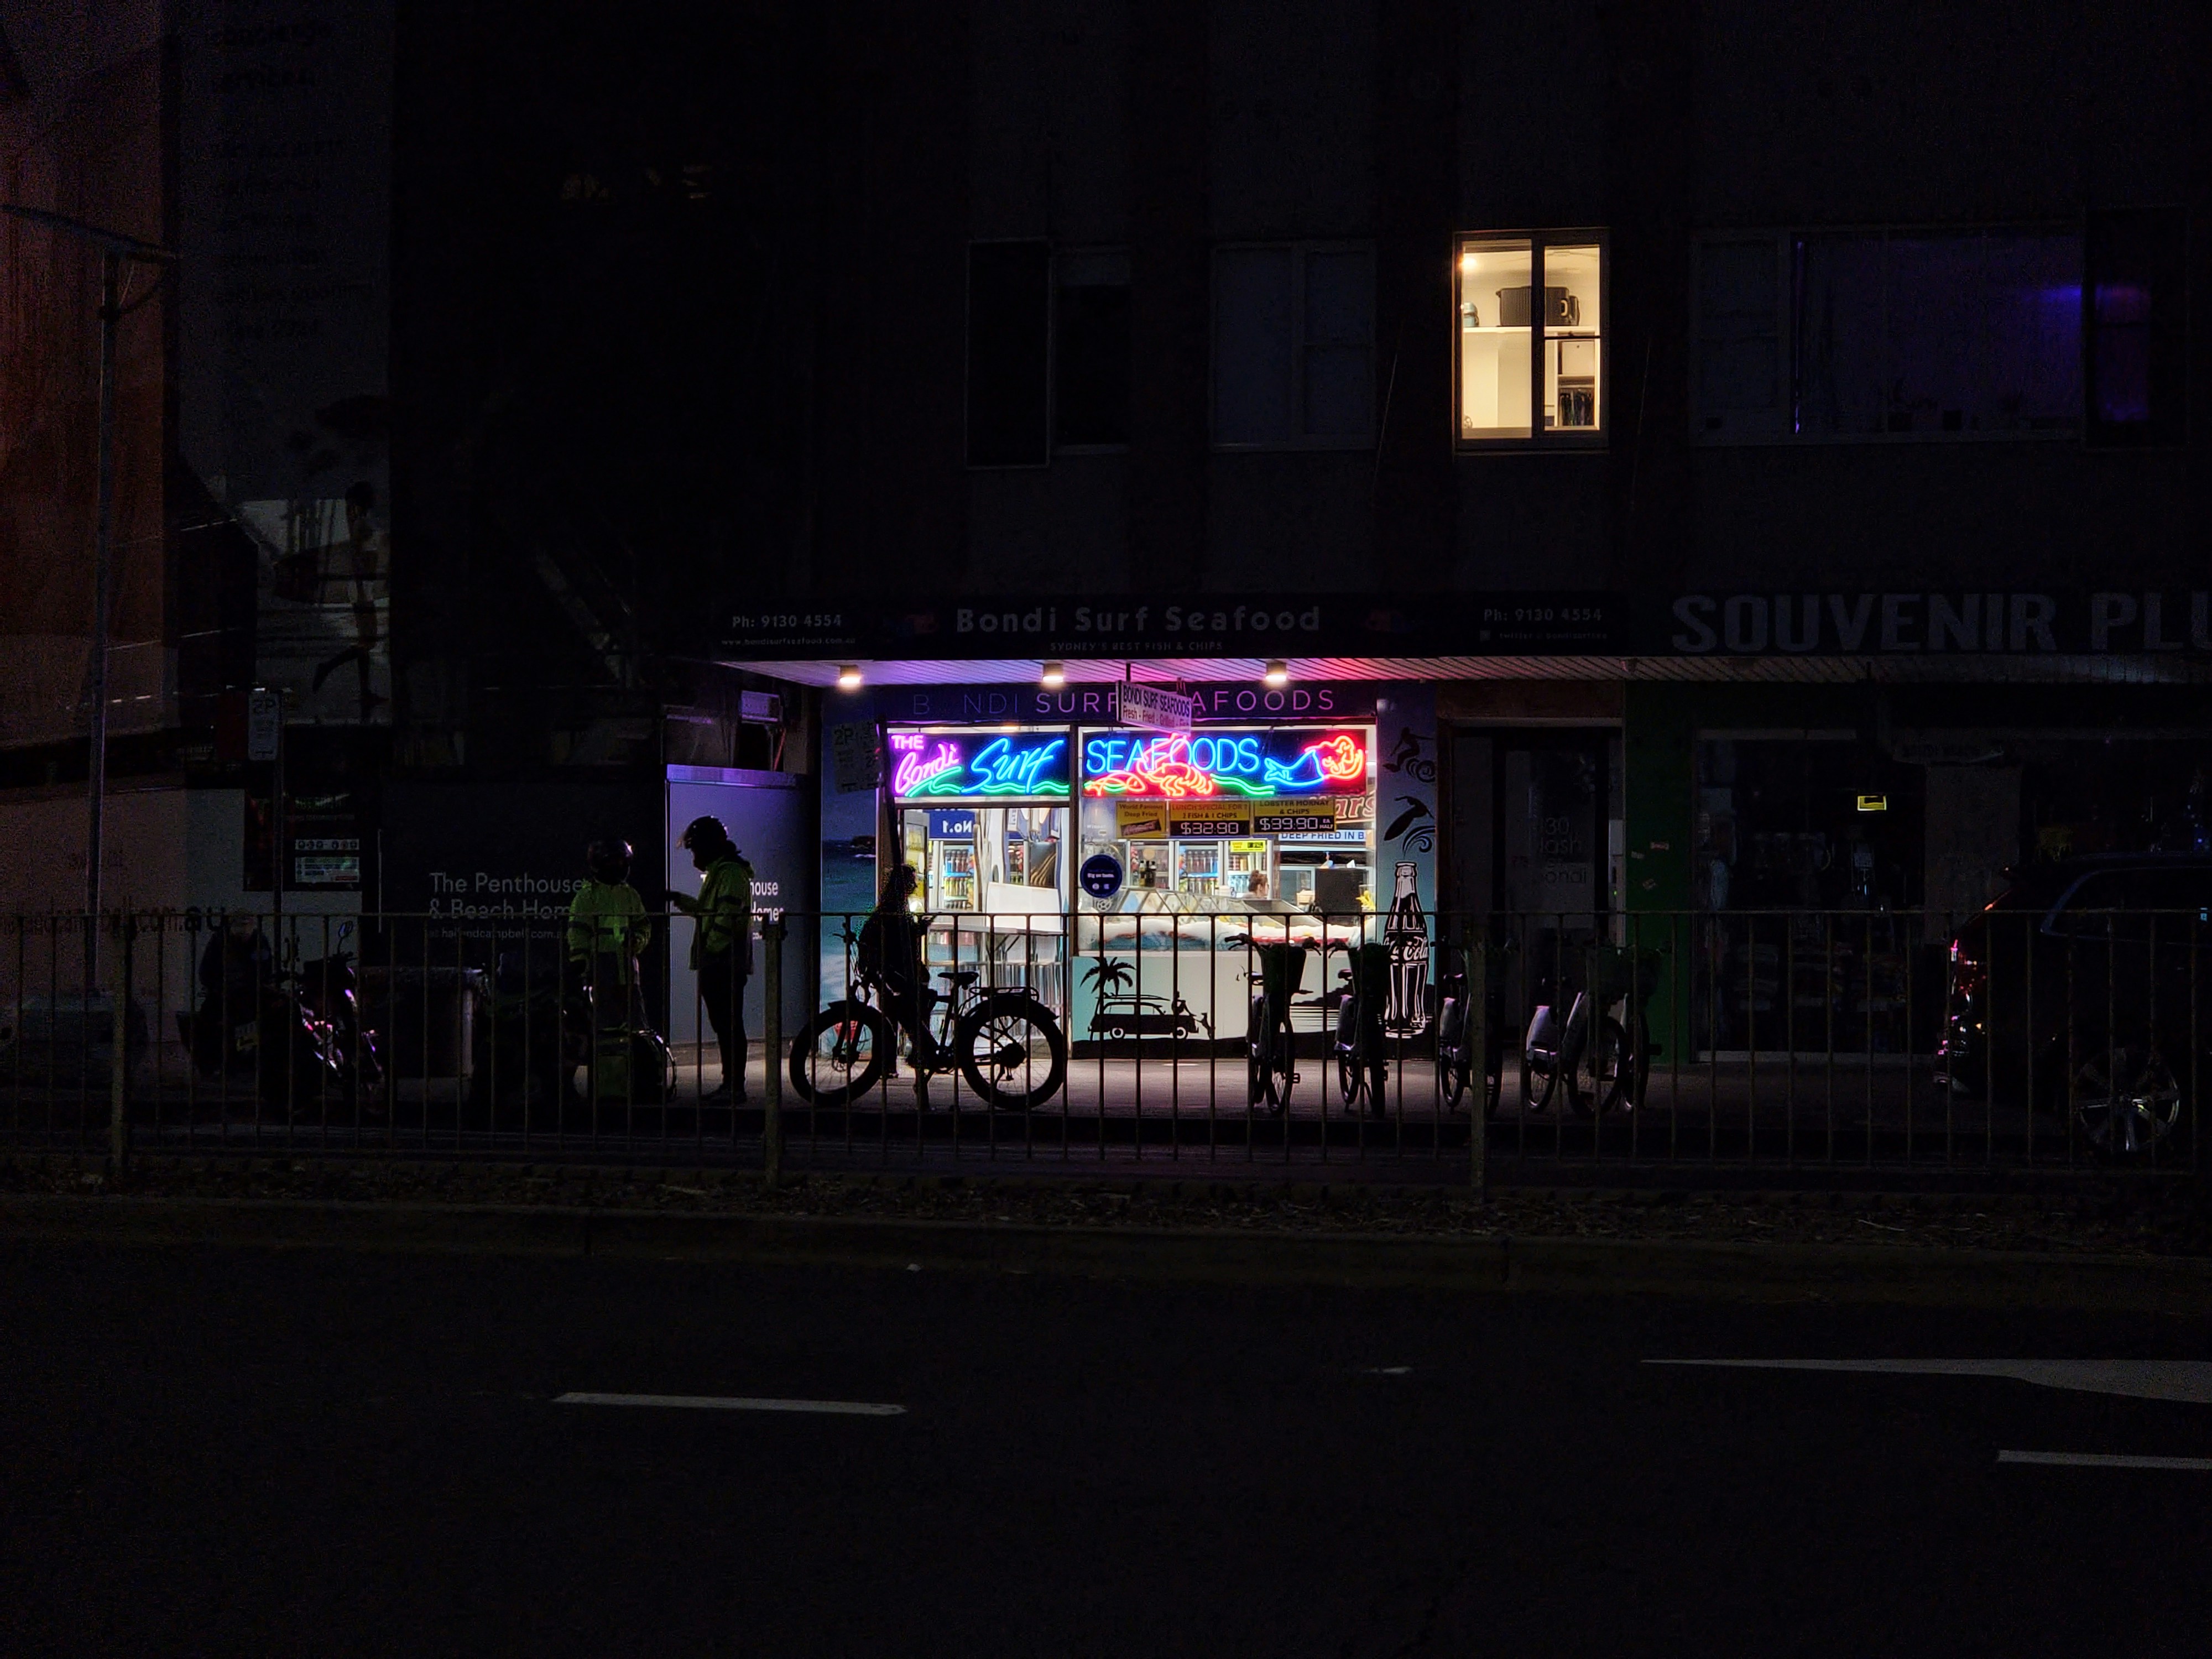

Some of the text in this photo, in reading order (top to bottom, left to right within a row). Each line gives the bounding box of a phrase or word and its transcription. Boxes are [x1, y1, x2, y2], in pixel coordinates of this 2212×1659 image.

[732, 614, 842, 628] Ph: 9130 4554
[957, 605, 1320, 633] Bondi Surf Seafood
[1484, 608, 1602, 622] Ph: 9130 4554
[1671, 592, 2057, 654] SOUVENIR
[1050, 641, 1223, 651] SYDNEY'S BEST FISH & CHIPS
[1035, 692, 1116, 714] SURF
[1191, 689, 1334, 711] AFOODS
[1123, 685, 1190, 718] BONDI SURF SEAFOODS
[1123, 705, 1138, 720] Fresh
[891, 734, 924, 750] THE
[894, 743, 960, 794] Bondi
[961, 737, 1065, 794] Surf
[1086, 737, 1260, 774] SEAFOODS
[1344, 831, 1355, 839] IN
[430, 872, 583, 894] The Penthouse
[429, 898, 570, 920] & Beach Hom
